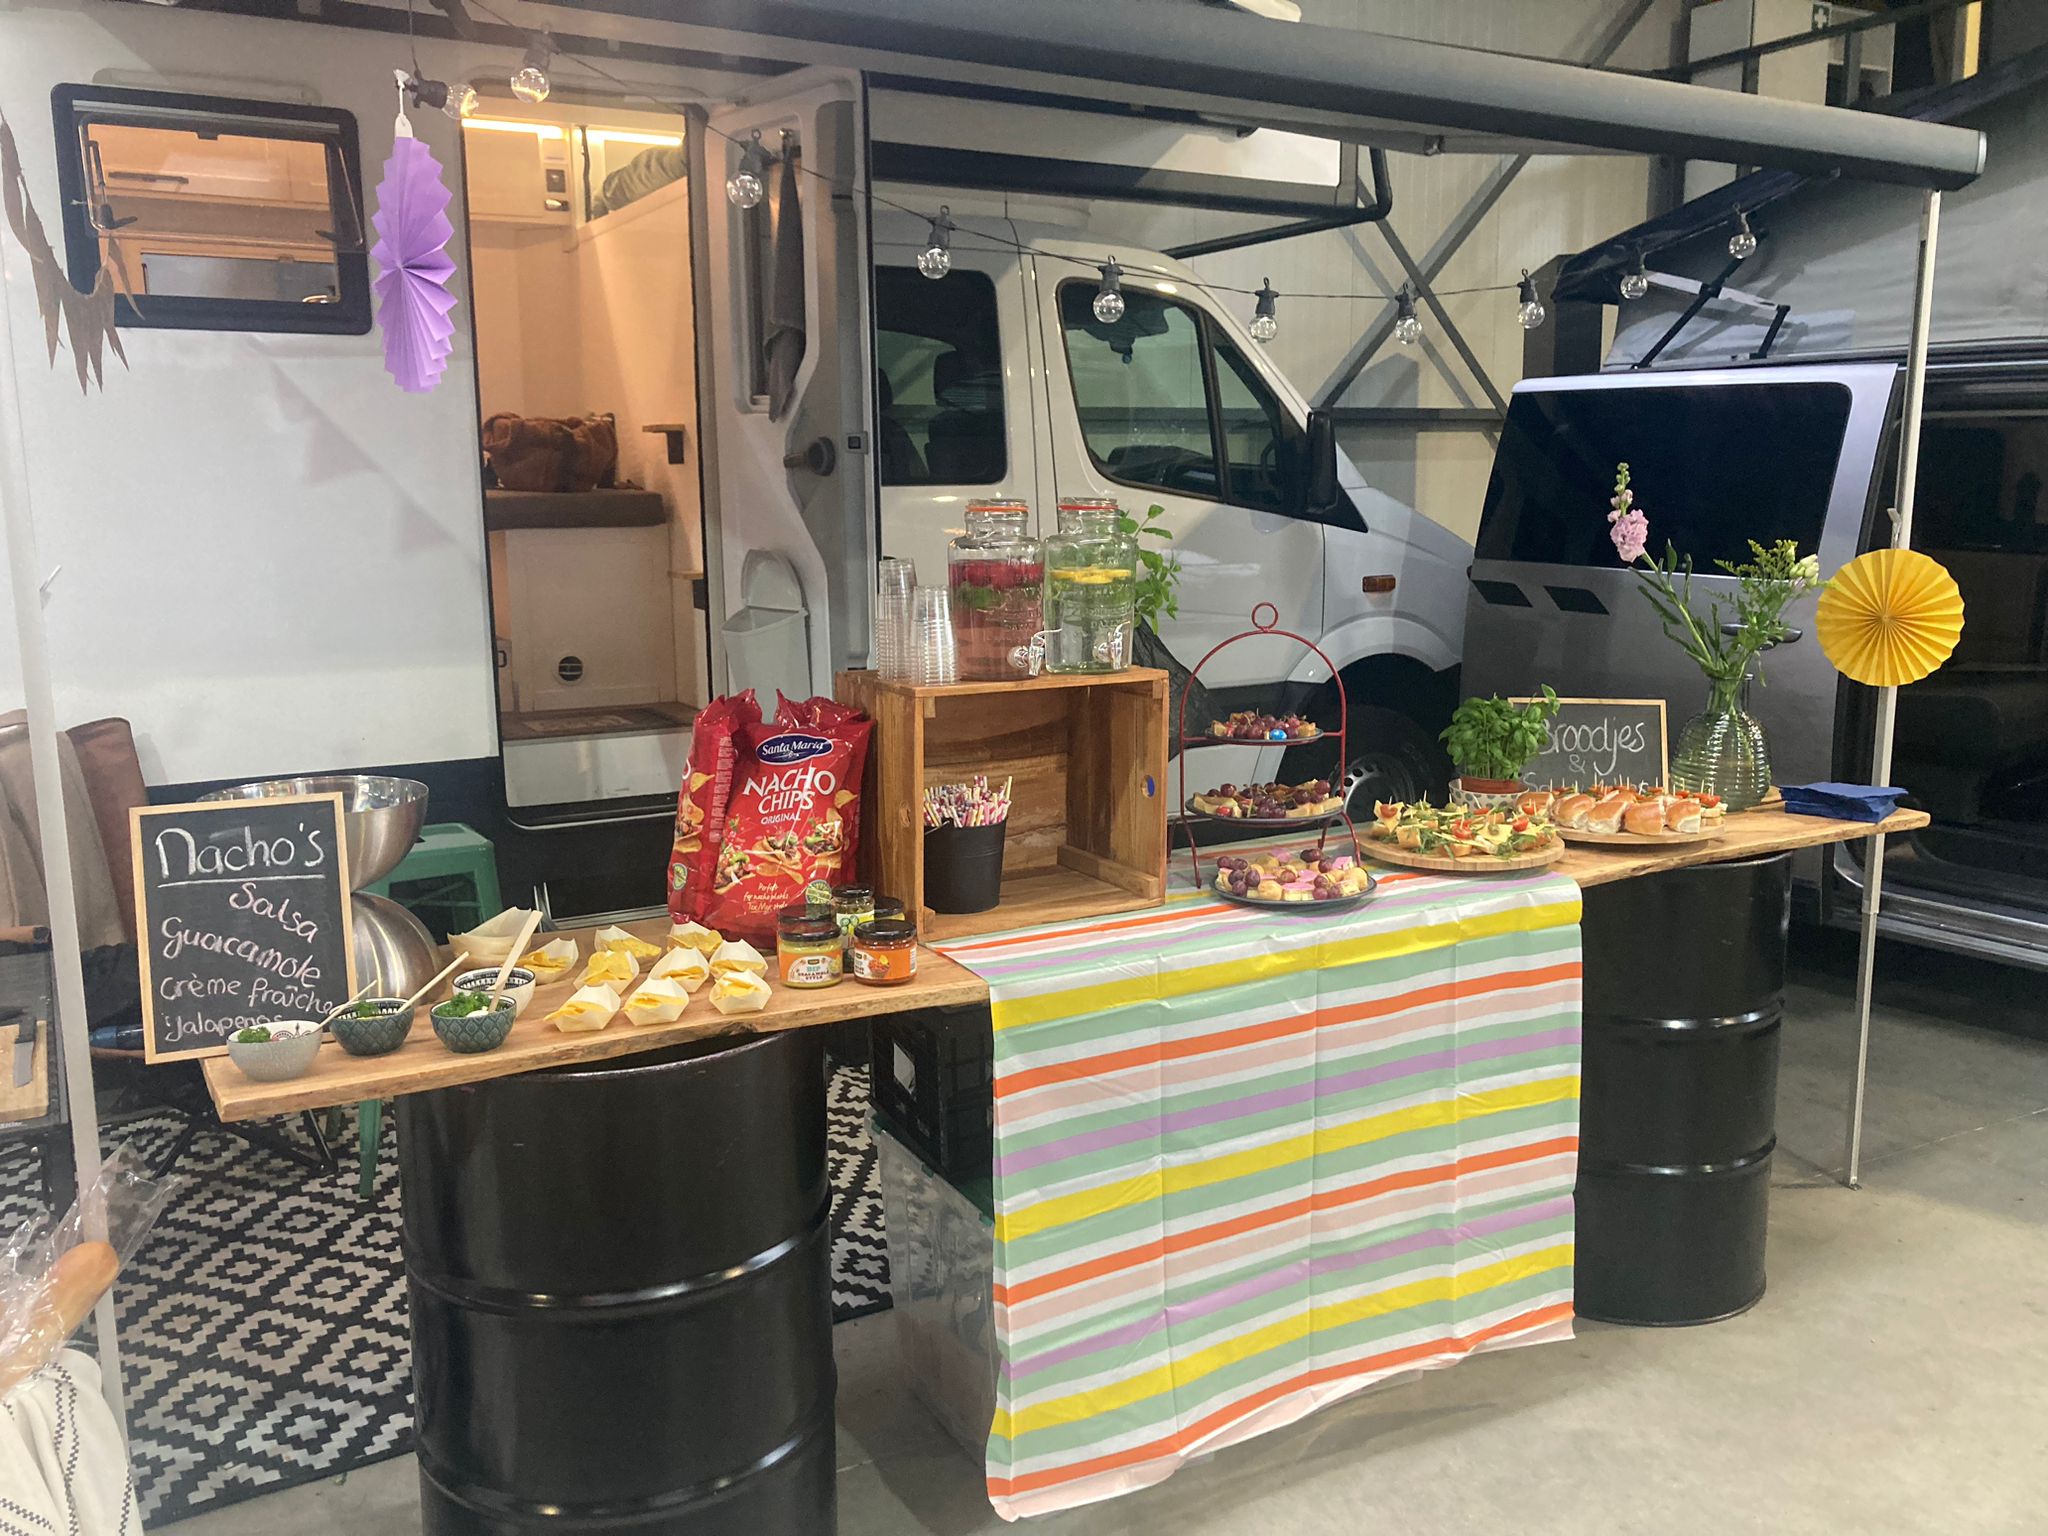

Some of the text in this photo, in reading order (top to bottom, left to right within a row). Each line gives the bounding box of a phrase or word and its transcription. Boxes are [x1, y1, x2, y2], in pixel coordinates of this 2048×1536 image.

[761, 740, 824, 756] Santa Maria
[1568, 753, 1586, 774] &
[742, 765, 836, 797] NACHO
[758, 789, 816, 814] CHIPS
[760, 811, 801, 825] ORIGINAL
[155, 822, 326, 879] Nacho's
[229, 881, 319, 944] Salsa
[161, 916, 321, 989] Guacamole
